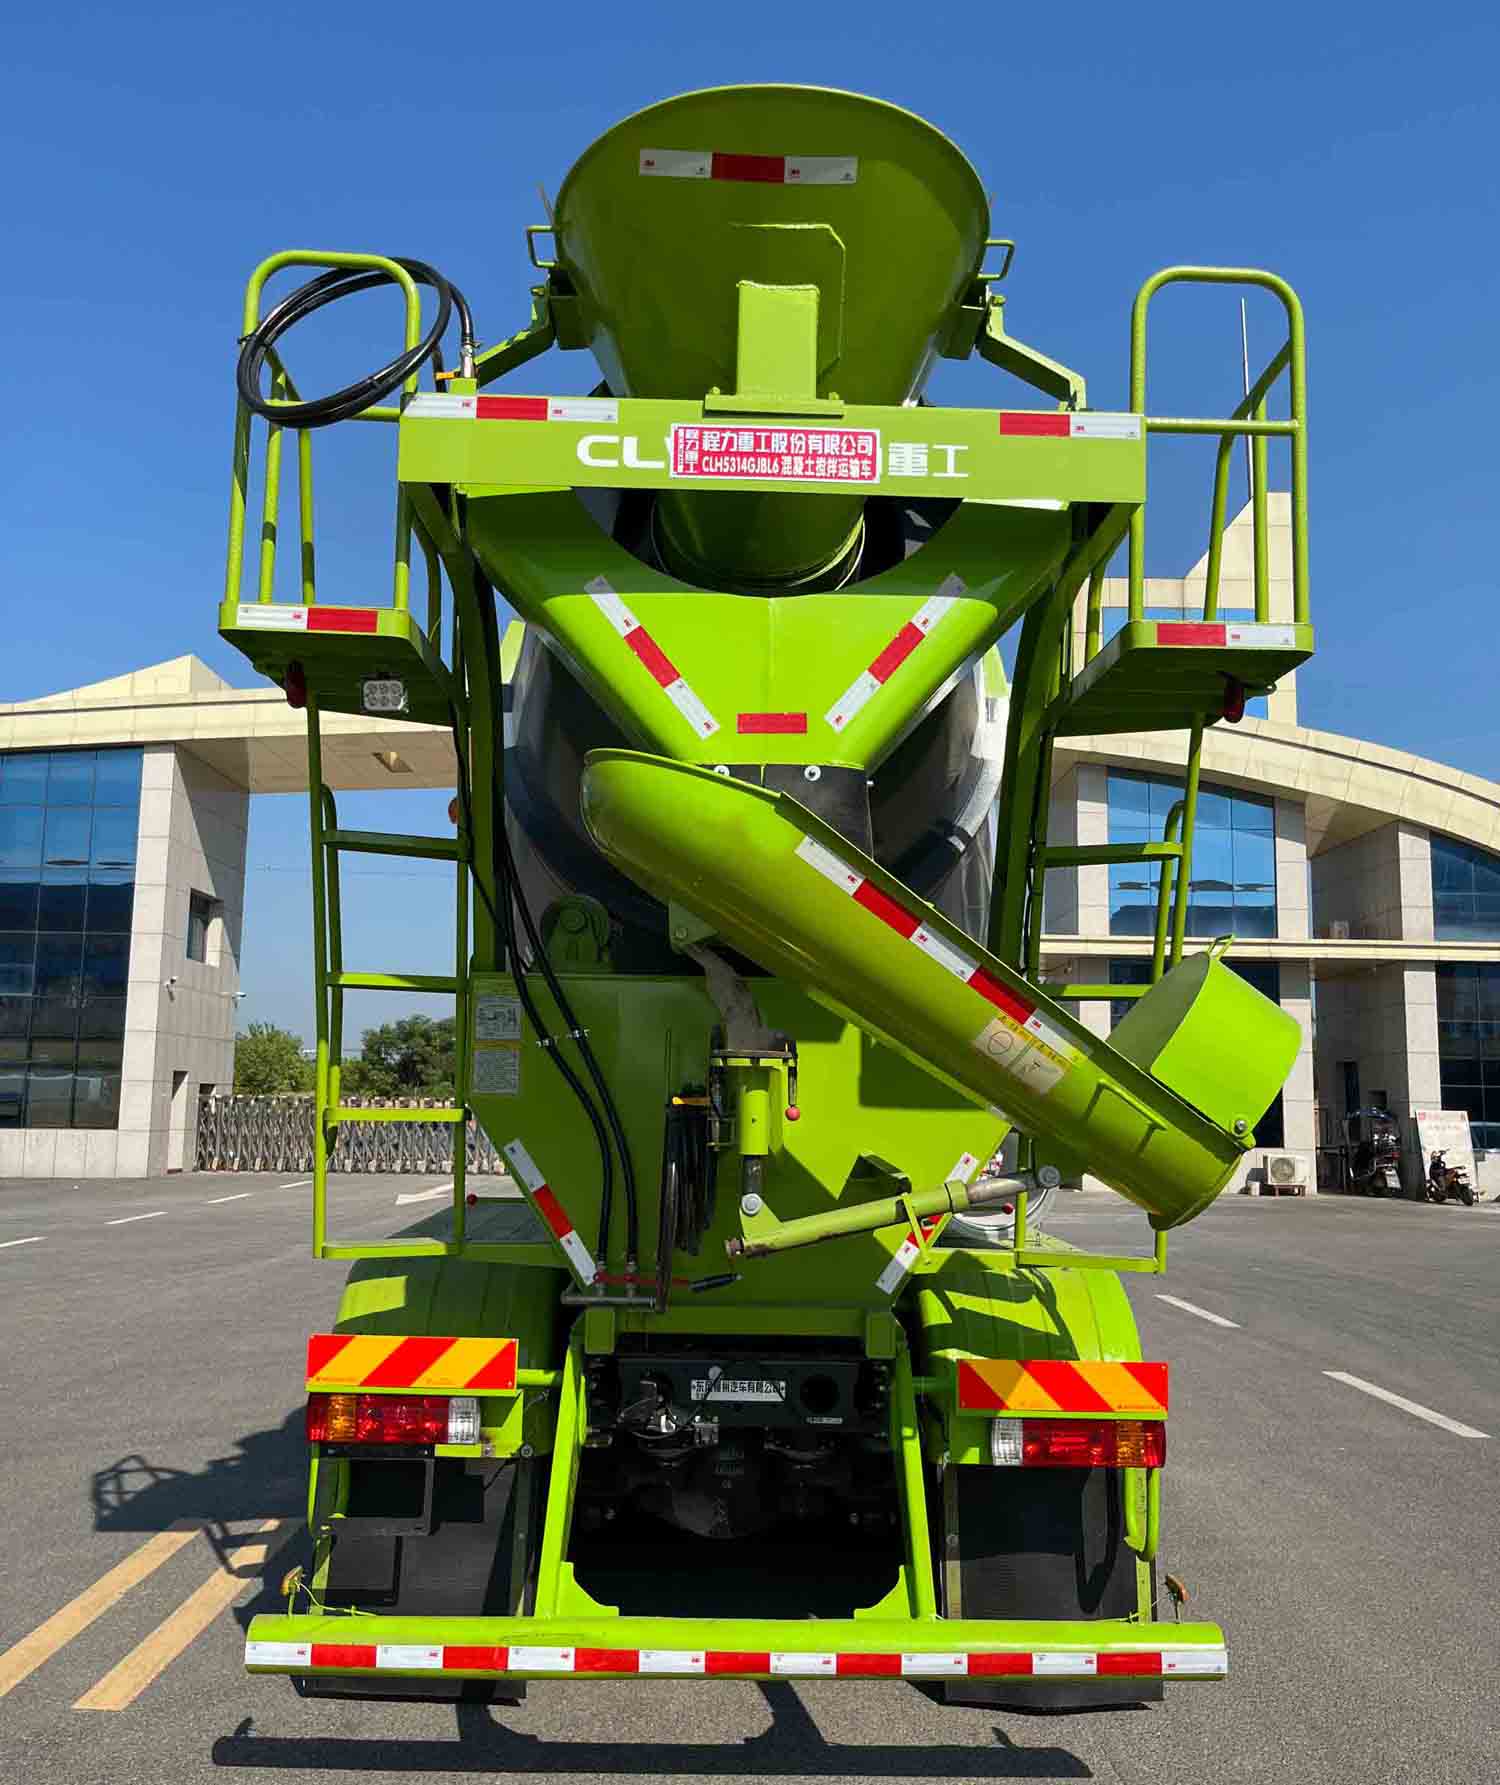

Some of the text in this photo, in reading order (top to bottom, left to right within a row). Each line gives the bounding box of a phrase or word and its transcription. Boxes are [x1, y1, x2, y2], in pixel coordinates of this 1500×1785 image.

[702, 431, 872, 455] 程力重工股份有限公司
